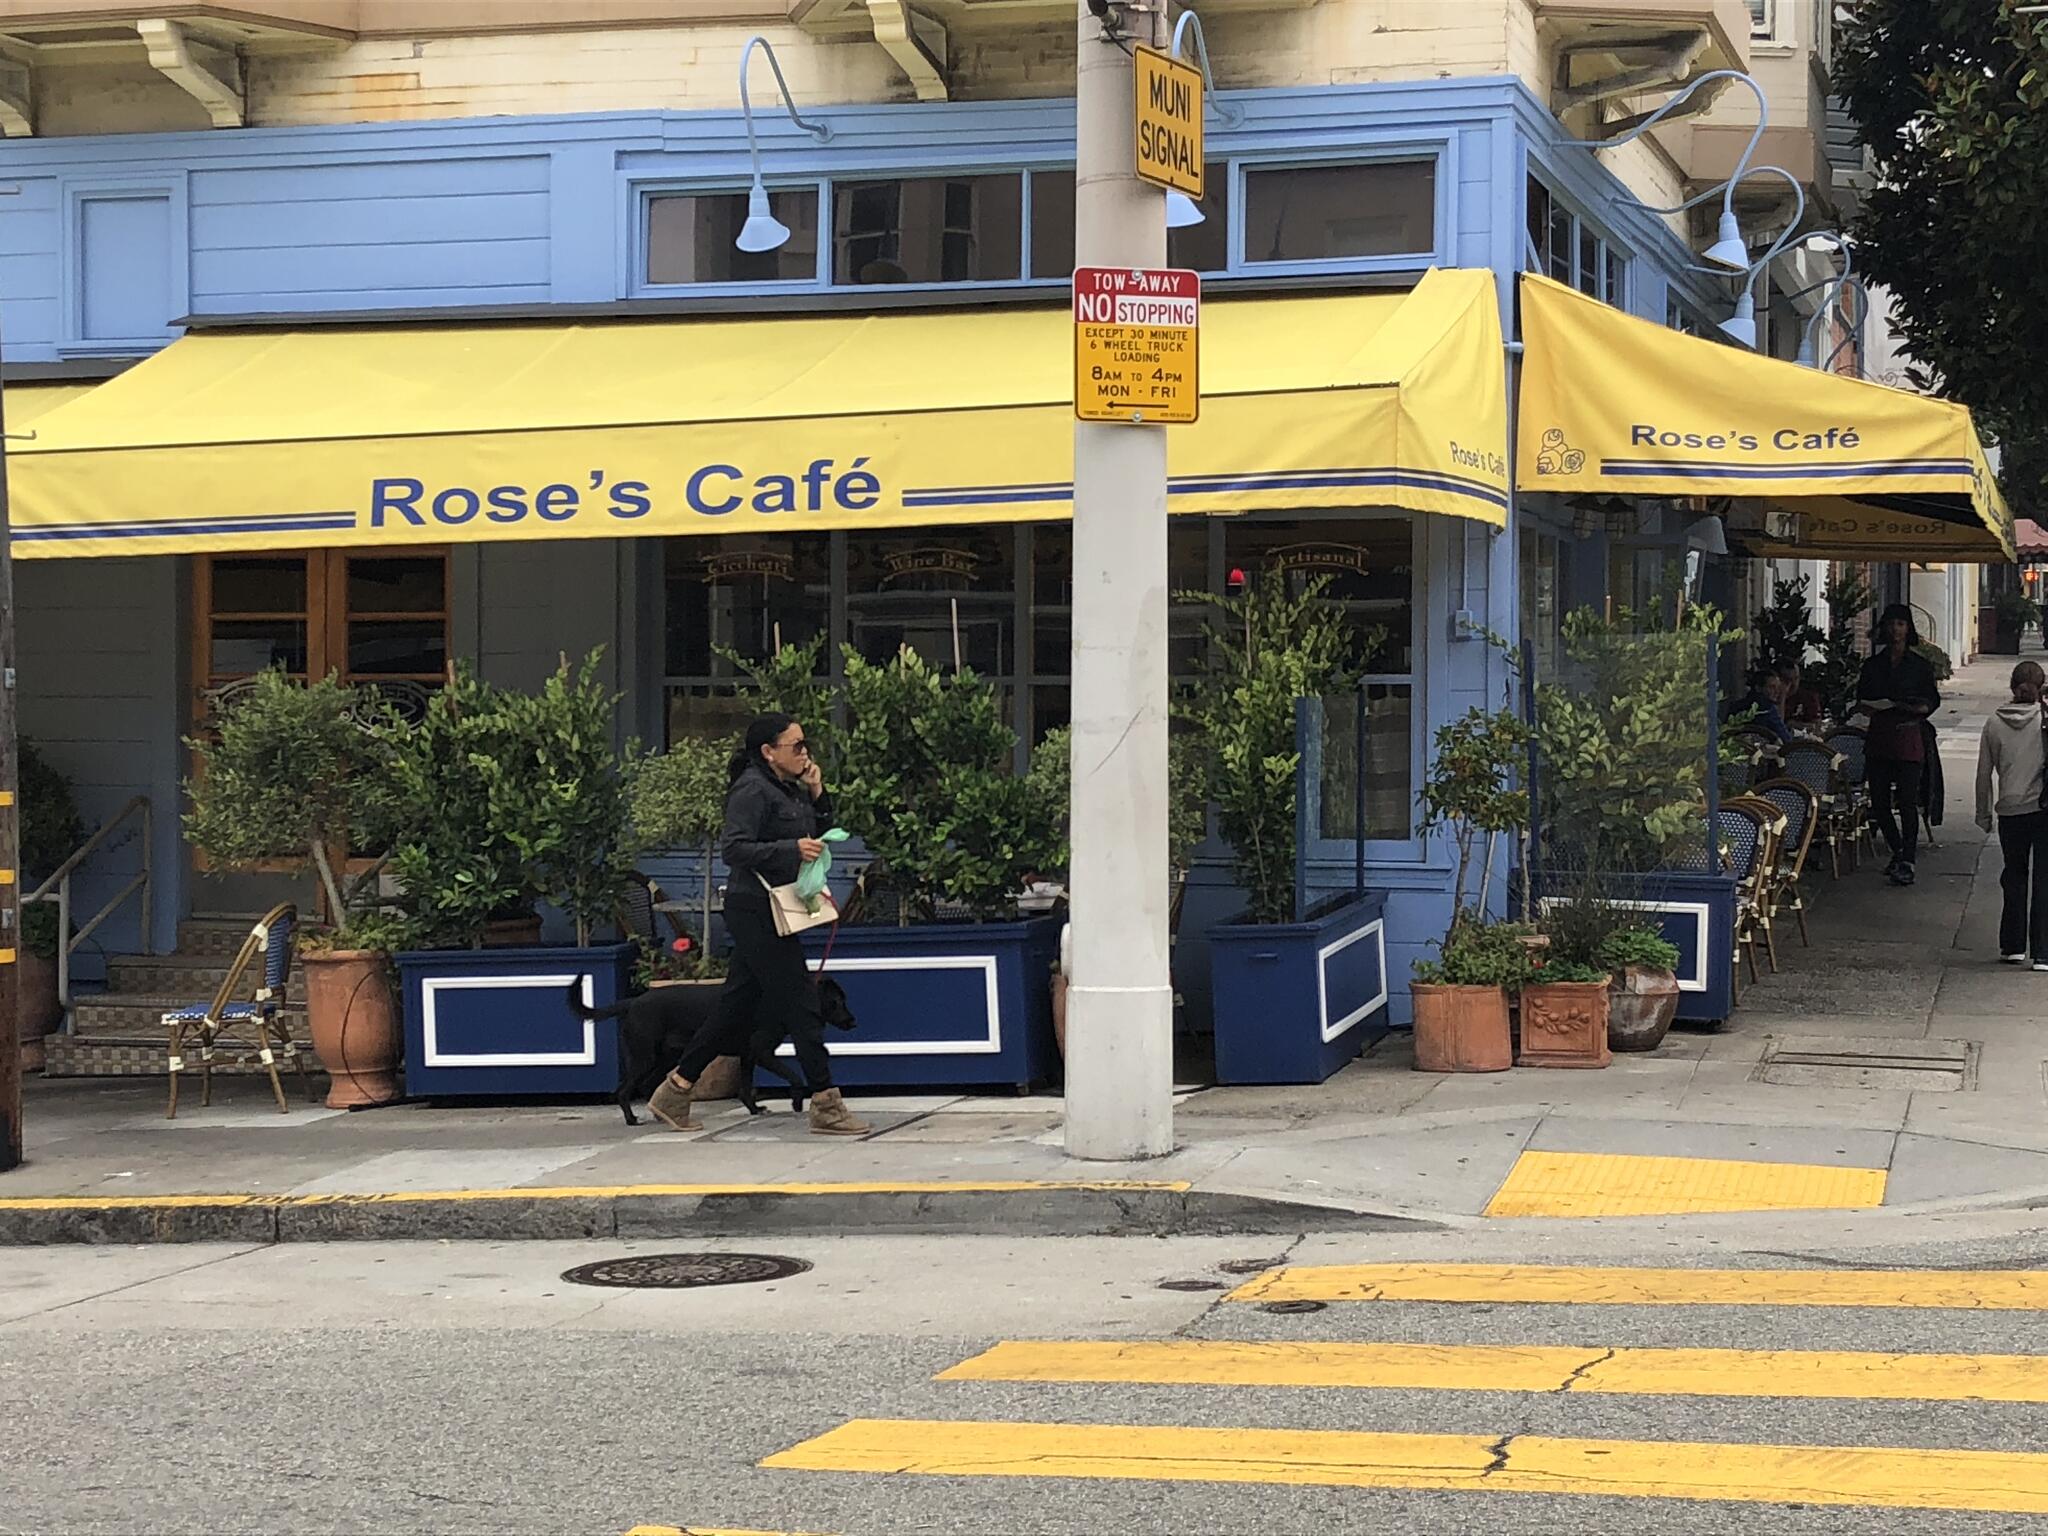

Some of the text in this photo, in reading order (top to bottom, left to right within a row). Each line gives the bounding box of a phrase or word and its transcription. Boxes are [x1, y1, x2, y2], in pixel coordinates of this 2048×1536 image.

[1150, 70, 1190, 123] MUNI
[1140, 120, 1199, 178] SIGNAL
[1078, 293, 1194, 325] NO STOPPING
[1085, 327, 1188, 341] EXCEPT 30 MINUTE
[1090, 340, 1184, 352] 6 WHEEL TRUCK
[1114, 352, 1160, 363] LOADING
[1091, 366, 1182, 383] 8AM TO 4PM
[1098, 384, 1130, 397] MON
[1151, 386, 1176, 398] FRI
[1773, 427, 1861, 451] Café
[685, 457, 881, 516] Café
[889, 554, 935, 571] Wine
[941, 552, 976, 571] Bar
